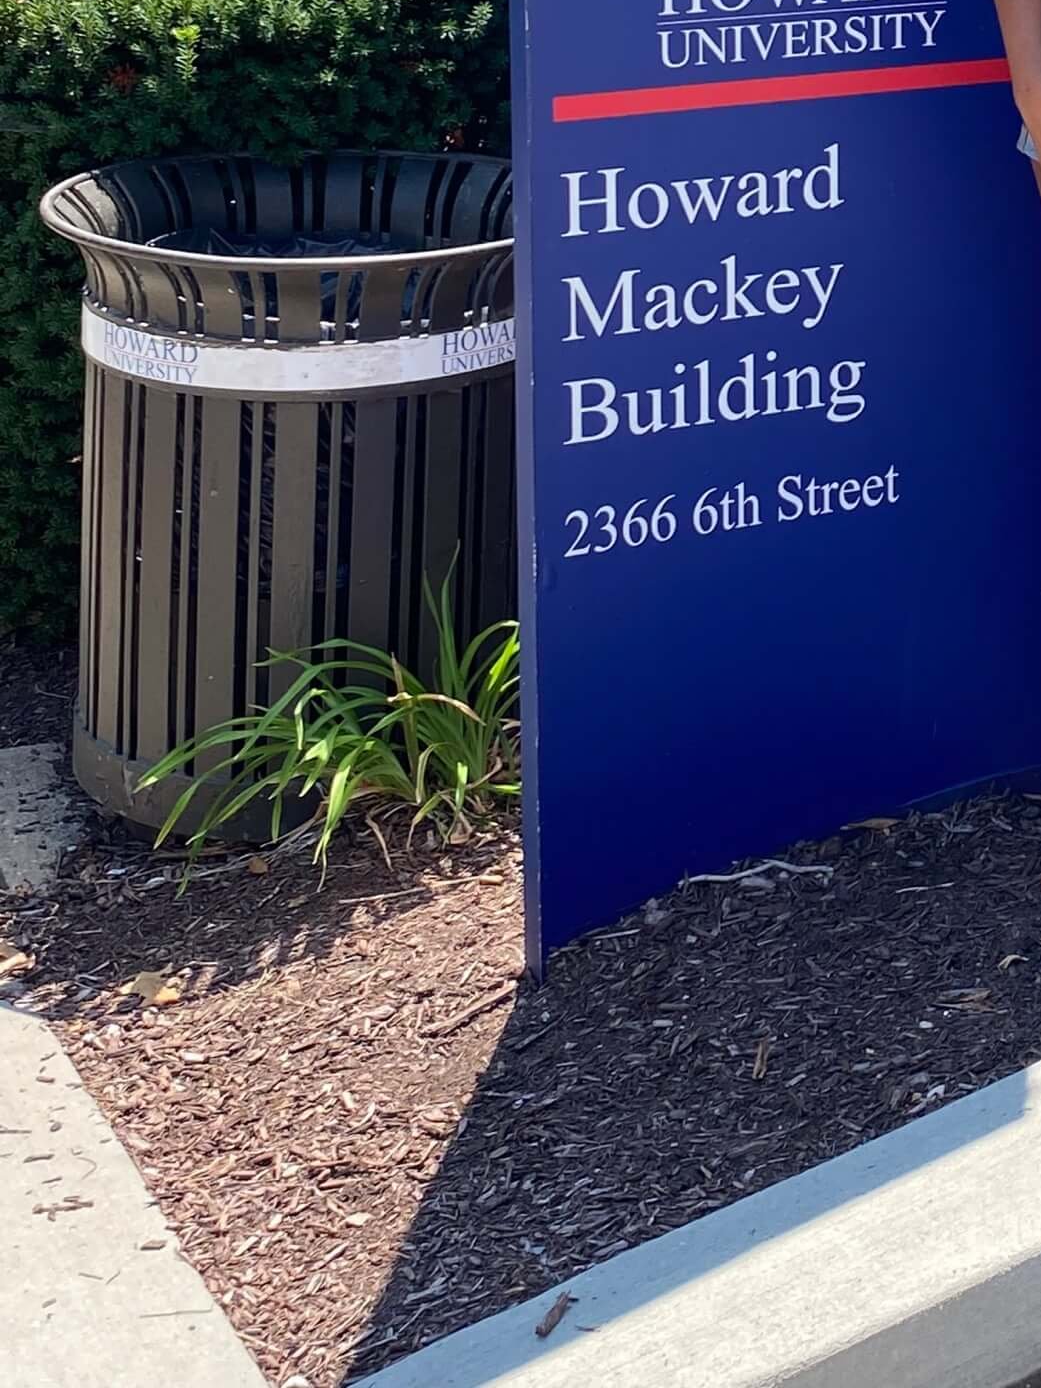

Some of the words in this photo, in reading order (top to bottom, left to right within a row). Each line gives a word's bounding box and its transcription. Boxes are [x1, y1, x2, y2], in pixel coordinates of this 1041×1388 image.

[657, 9, 946, 69] UNIVERSITY
[560, 143, 845, 237] Howard
[562, 255, 844, 342] Mackey
[104, 323, 198, 363] HOWARD
[104, 346, 197, 383] UNIVERSITY
[441, 319, 516, 355] HOWA
[562, 350, 866, 445] Building
[564, 494, 677, 558] 2366
[693, 482, 762, 535] 6th
[778, 465, 900, 522] Street
